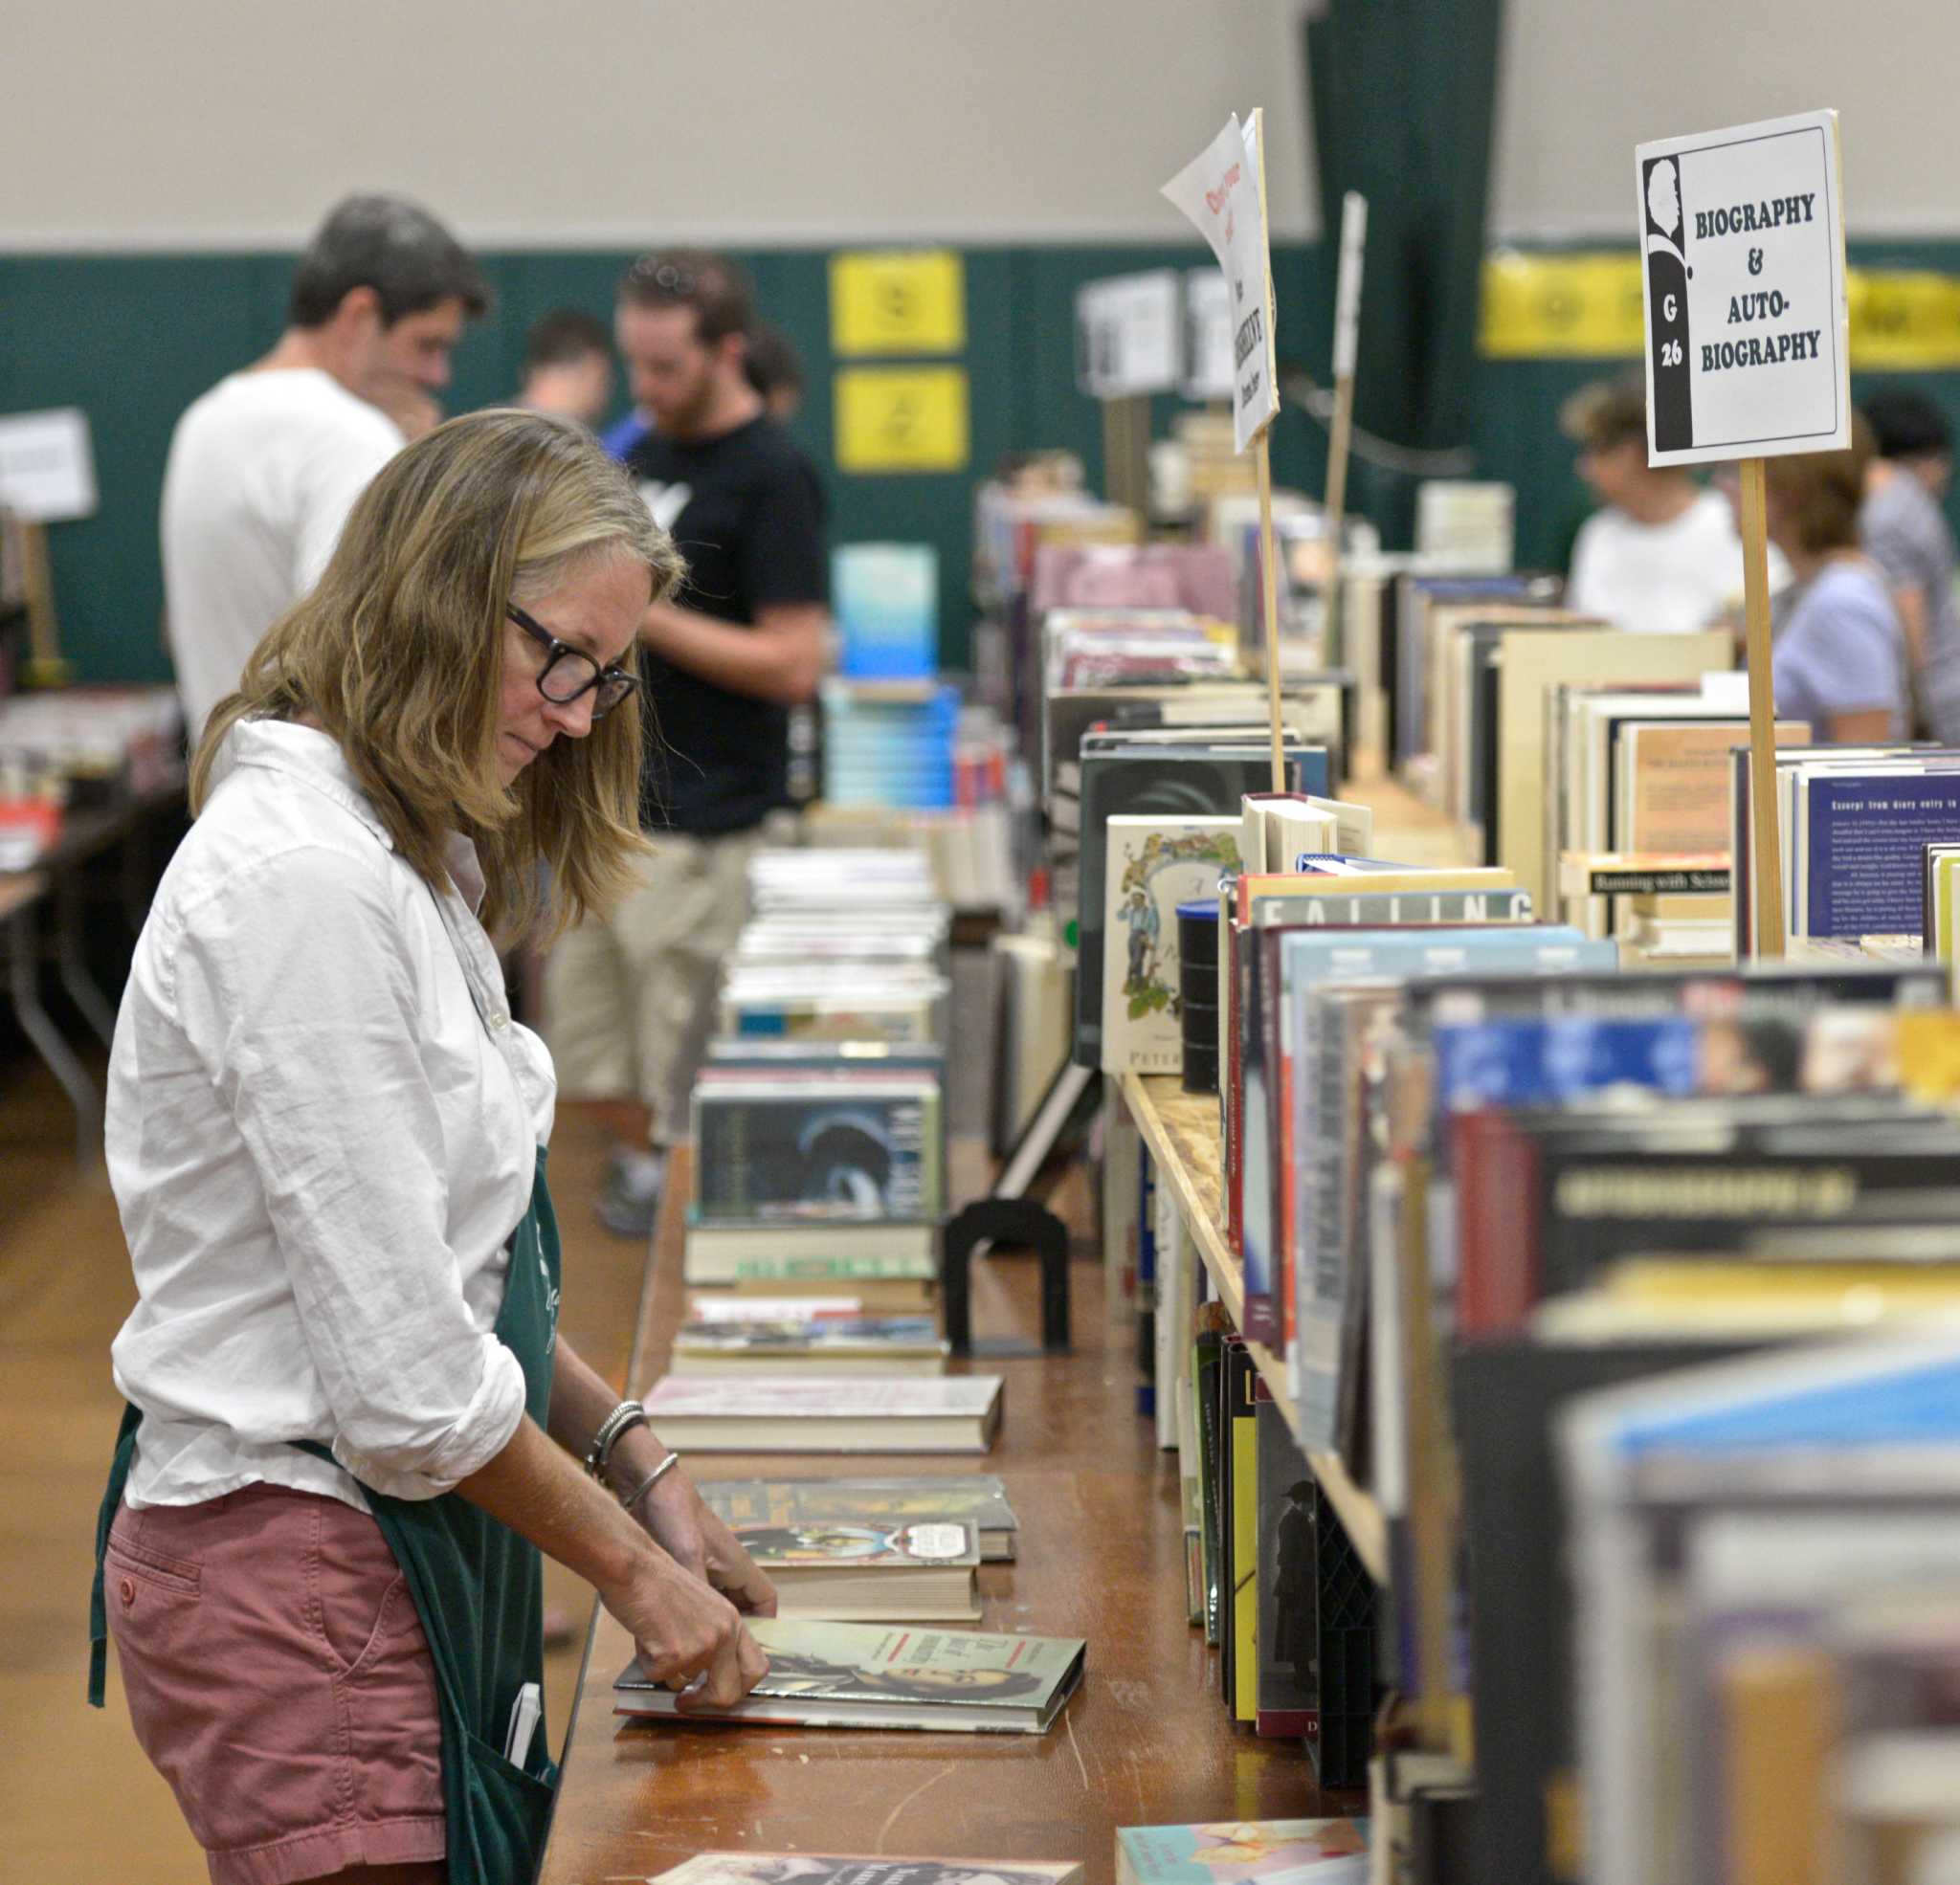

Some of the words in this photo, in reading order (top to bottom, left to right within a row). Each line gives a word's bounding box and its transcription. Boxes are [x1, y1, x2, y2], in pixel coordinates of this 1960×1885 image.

[1695, 193, 1815, 239] BIOGRAPHY
[1748, 248, 1763, 276] &
[1663, 295, 1678, 322] G
[1726, 290, 1790, 324] AUTO-
[1660, 340, 1682, 366] 26
[1701, 330, 1820, 372] BIOGRAPHY
[1832, 800, 1864, 810] Excerpt
[1868, 800, 1888, 809] from
[1893, 800, 1916, 810] diary
[1594, 874, 1654, 892] Running
[1656, 873, 1688, 889] with
